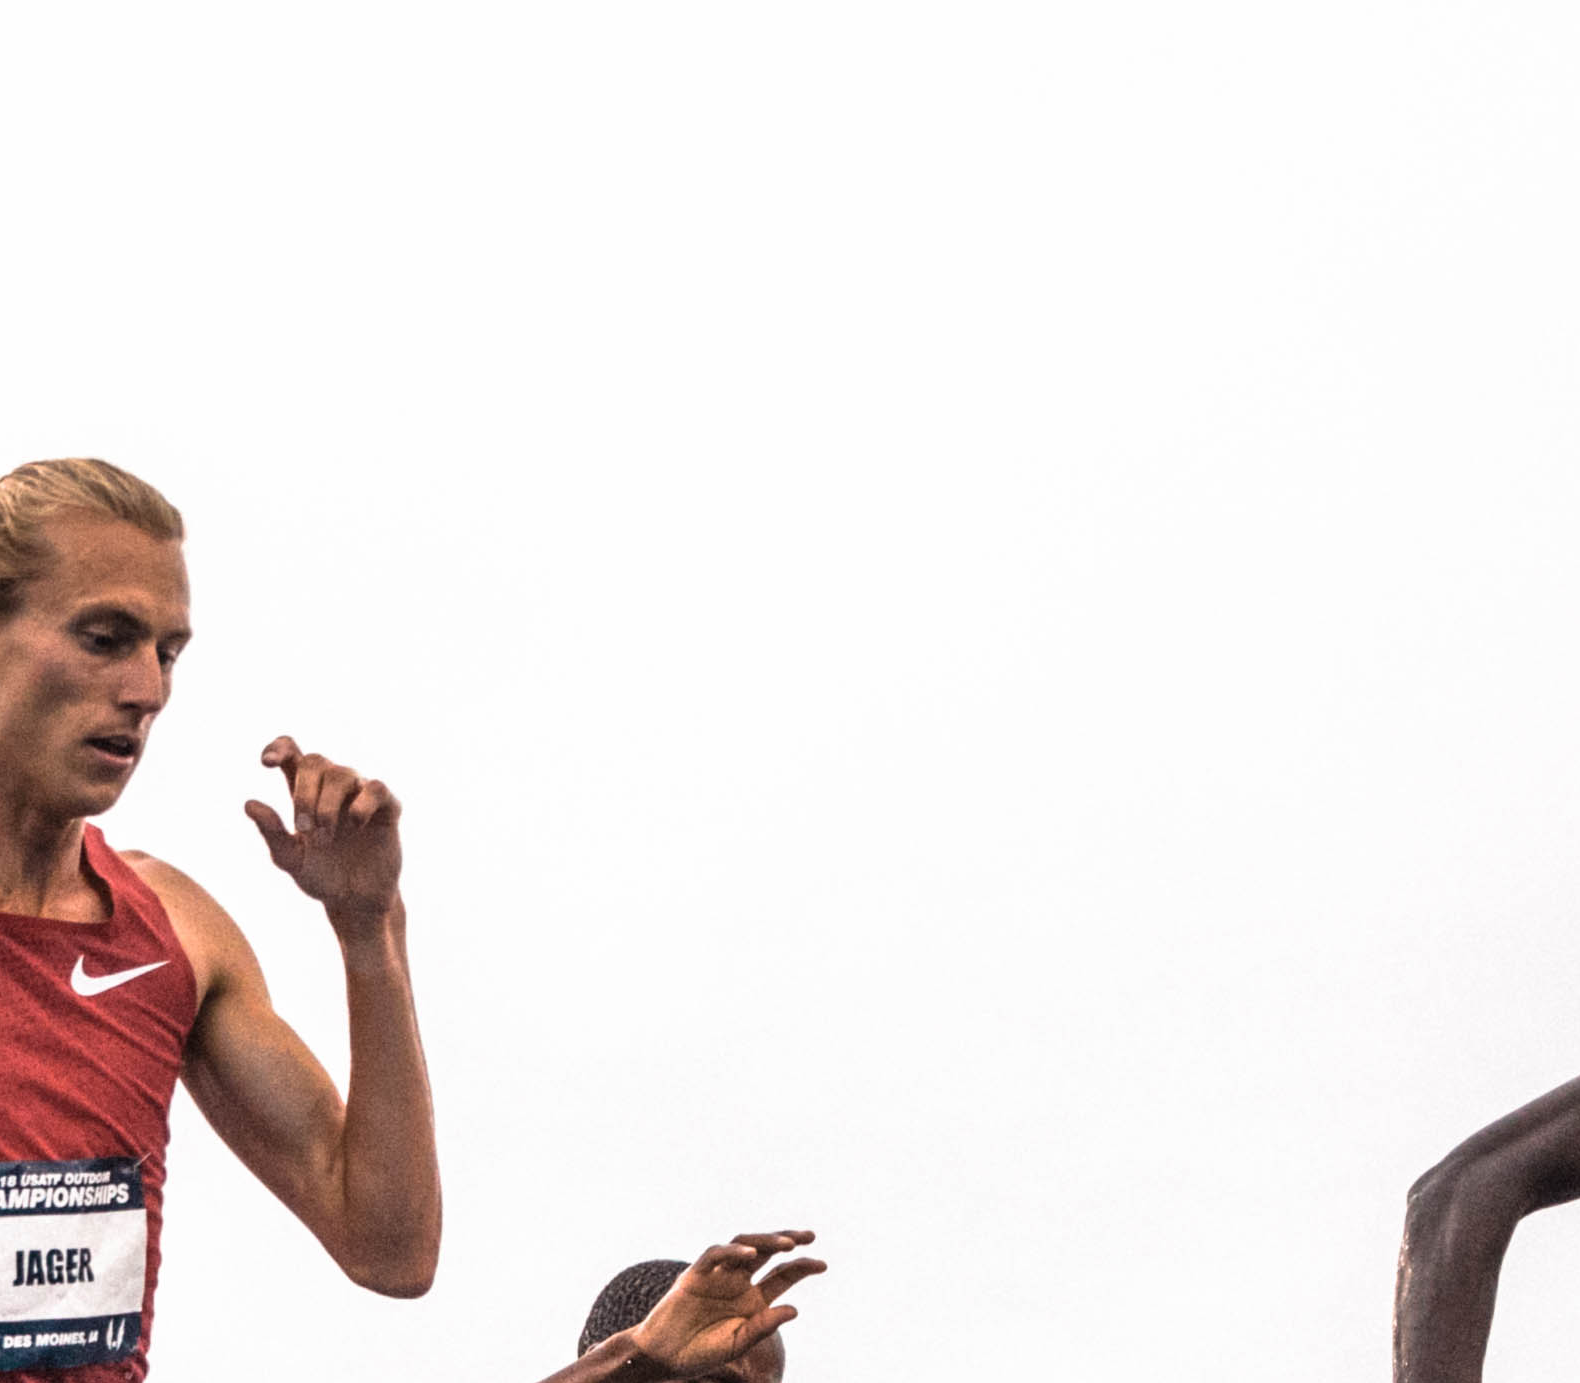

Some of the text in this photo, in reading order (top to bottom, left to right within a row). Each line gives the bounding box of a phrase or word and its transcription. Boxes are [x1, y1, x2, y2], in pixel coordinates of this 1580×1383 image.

[21, 1173, 62, 1186] USATF
[13, 1248, 94, 1287] JAGER
[3, 1334, 32, 1349] DES
[35, 1331, 86, 1347] MOINES,
